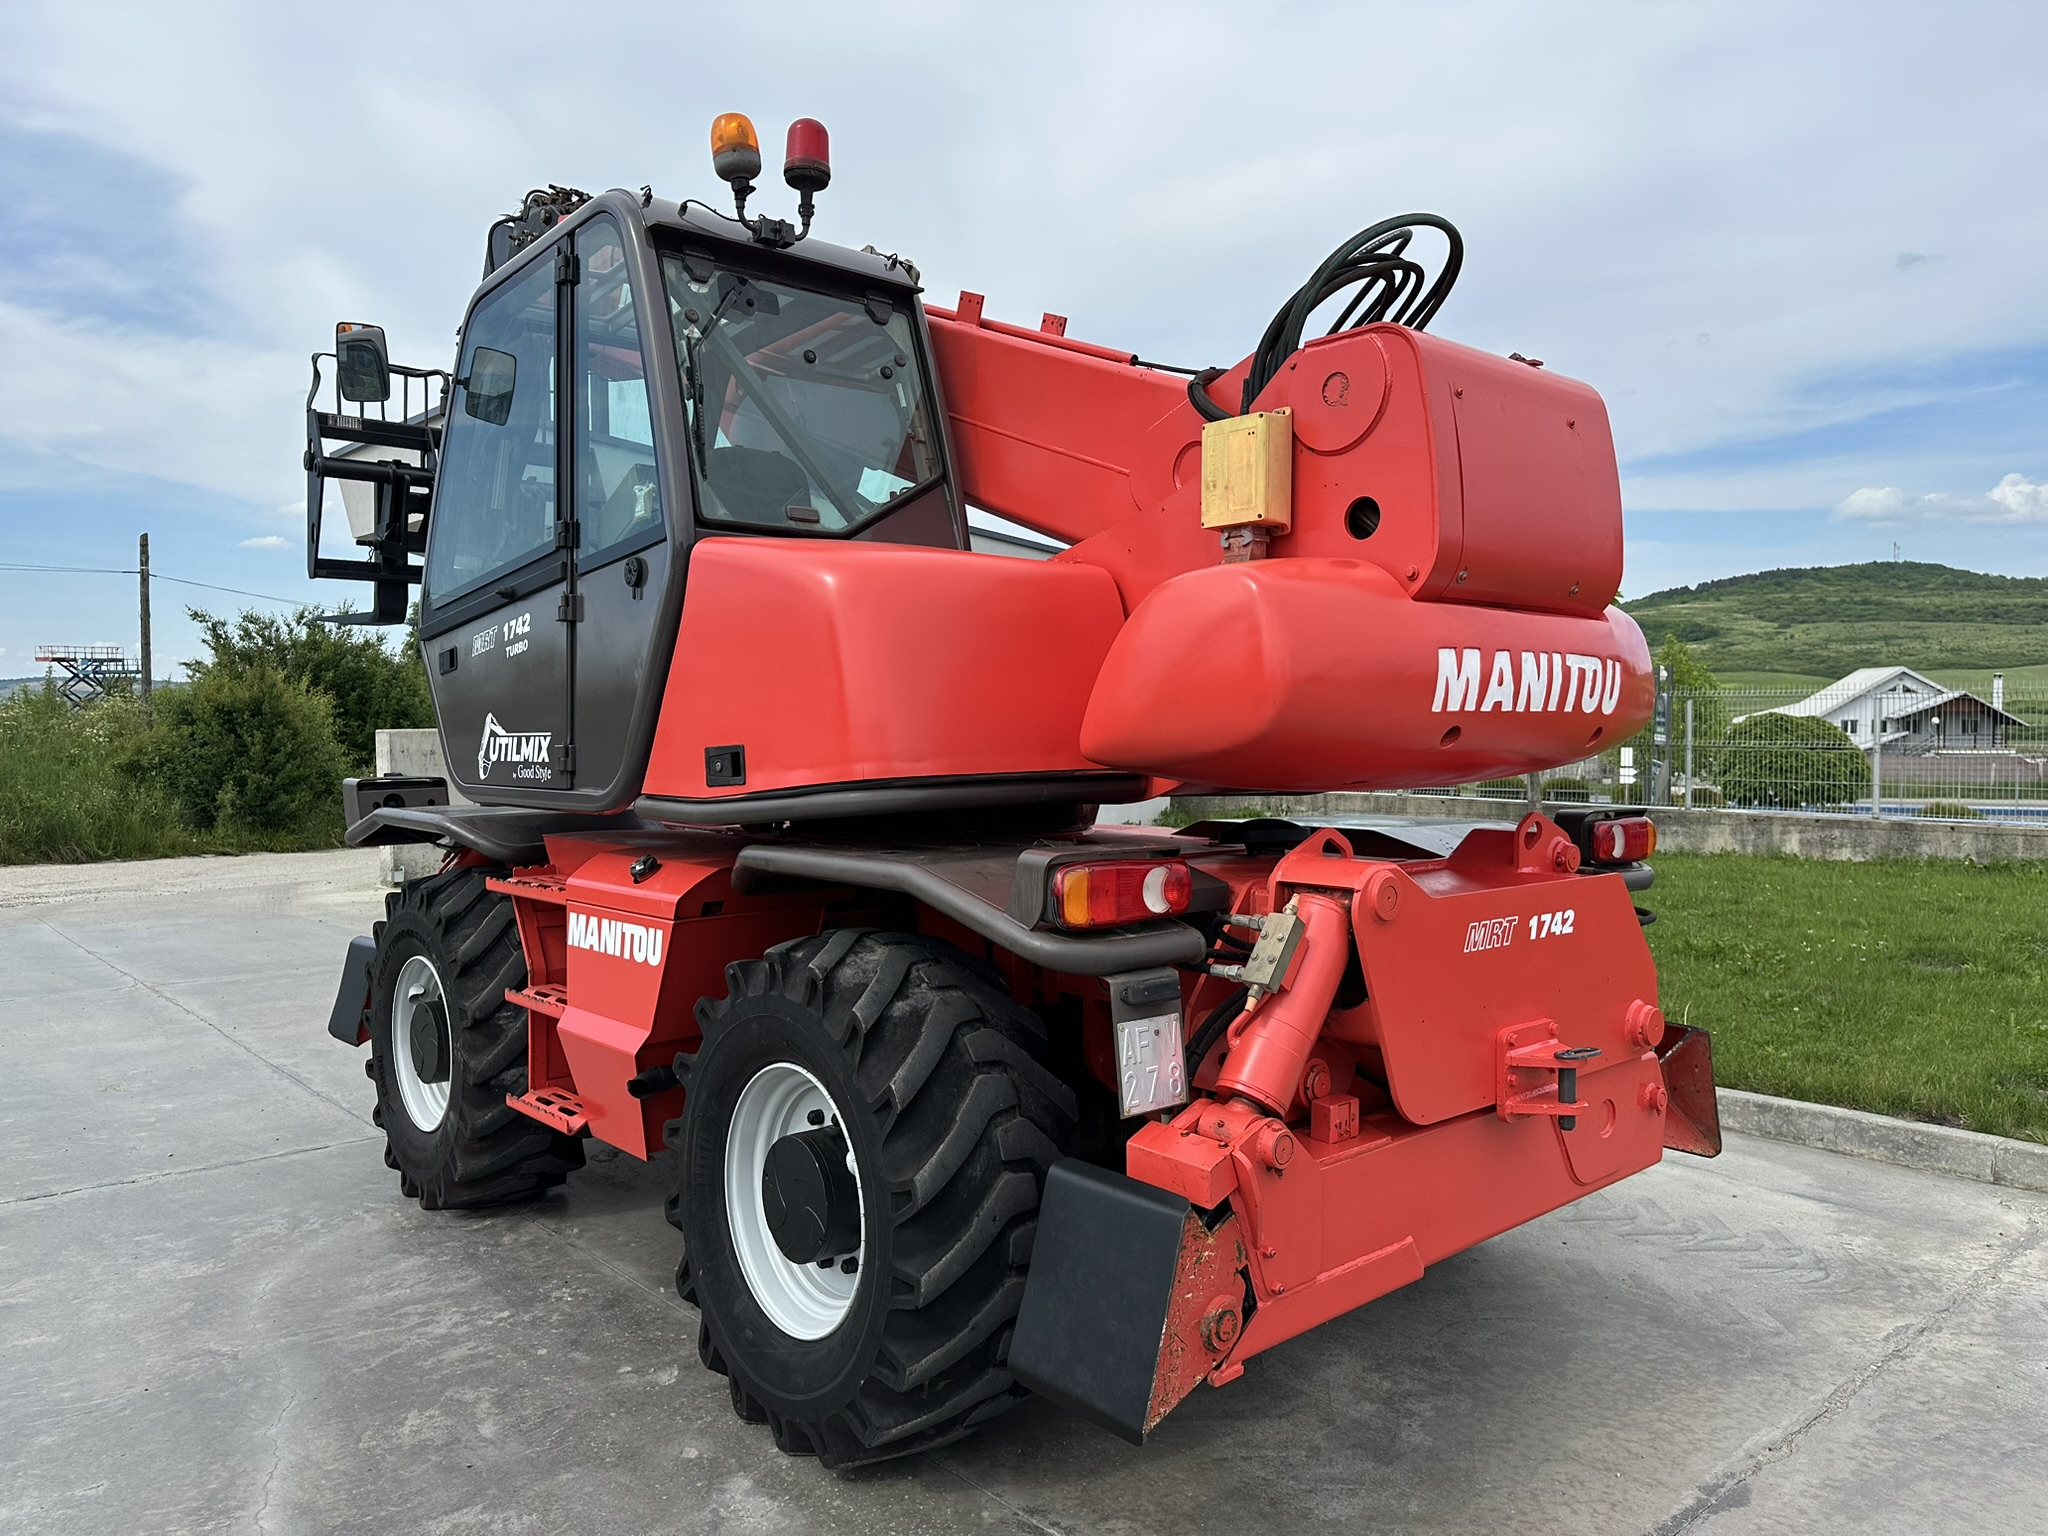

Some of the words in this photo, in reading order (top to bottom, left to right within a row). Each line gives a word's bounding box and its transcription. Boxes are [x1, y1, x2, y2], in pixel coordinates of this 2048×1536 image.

[471, 625, 498, 657] MRT
[502, 612, 531, 642] 1742
[505, 639, 529, 659] TURBO
[1431, 647, 1622, 716] MANITOU
[489, 736, 552, 763] UTILMIX
[517, 765, 534, 780] Good
[535, 765, 552, 783] Style
[567, 911, 664, 967] MANITOU
[1463, 916, 1519, 954] MRT
[1529, 909, 1576, 941] 1742
[1122, 1025, 1150, 1067] AF
[1124, 1061, 1183, 1109] 278
